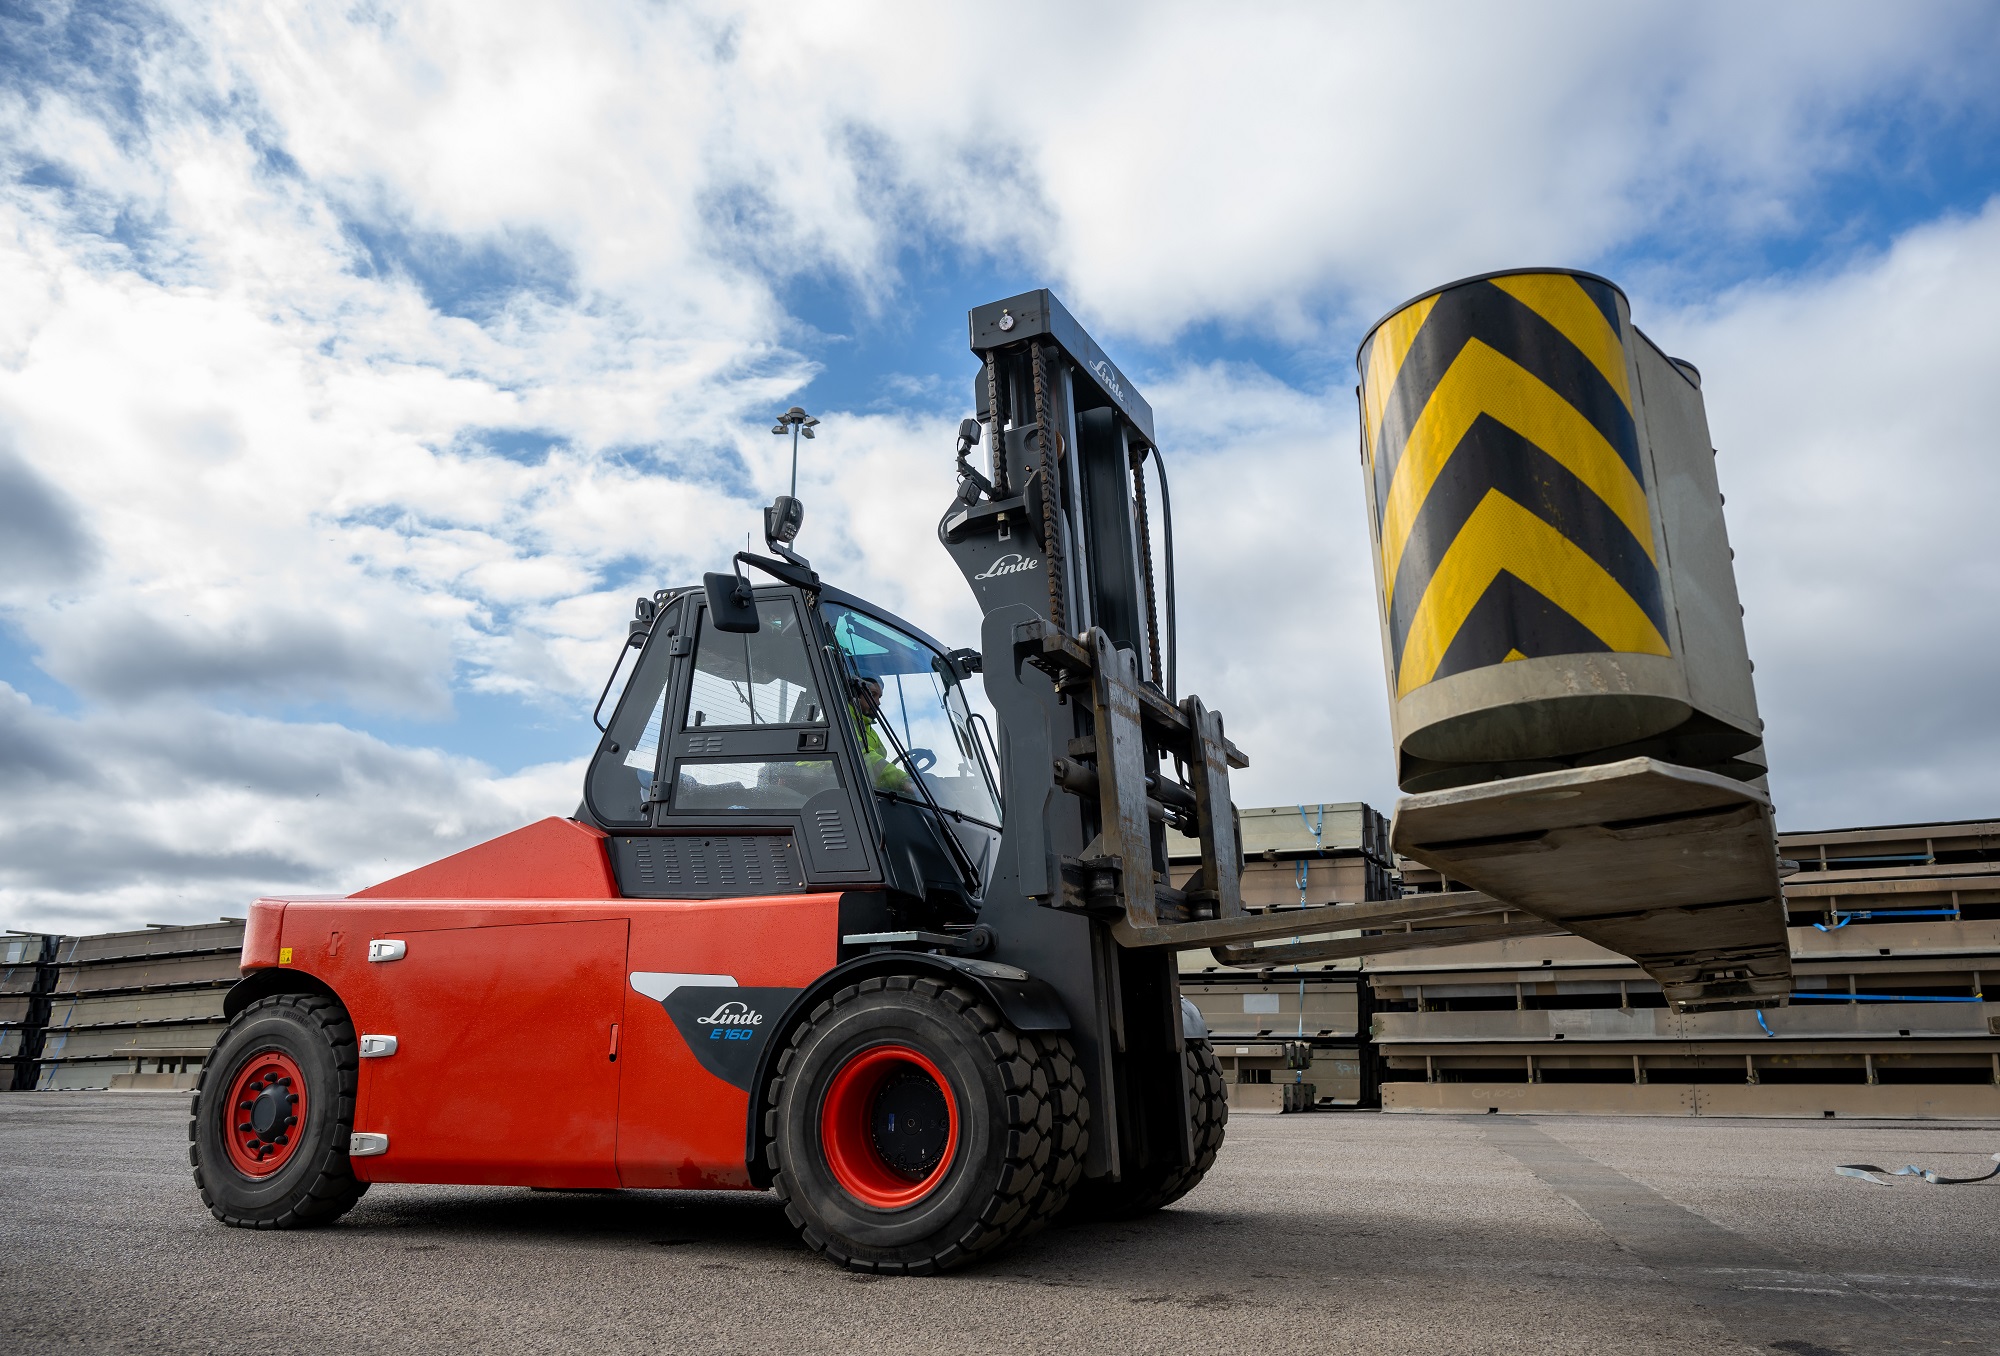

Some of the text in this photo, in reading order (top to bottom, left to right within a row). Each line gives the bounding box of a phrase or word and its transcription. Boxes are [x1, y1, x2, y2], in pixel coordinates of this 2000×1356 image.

[1089, 360, 1124, 401] Linde
[974, 553, 1038, 580] Linde
[696, 1001, 763, 1025] Linde
[709, 1028, 753, 1040] E 160
